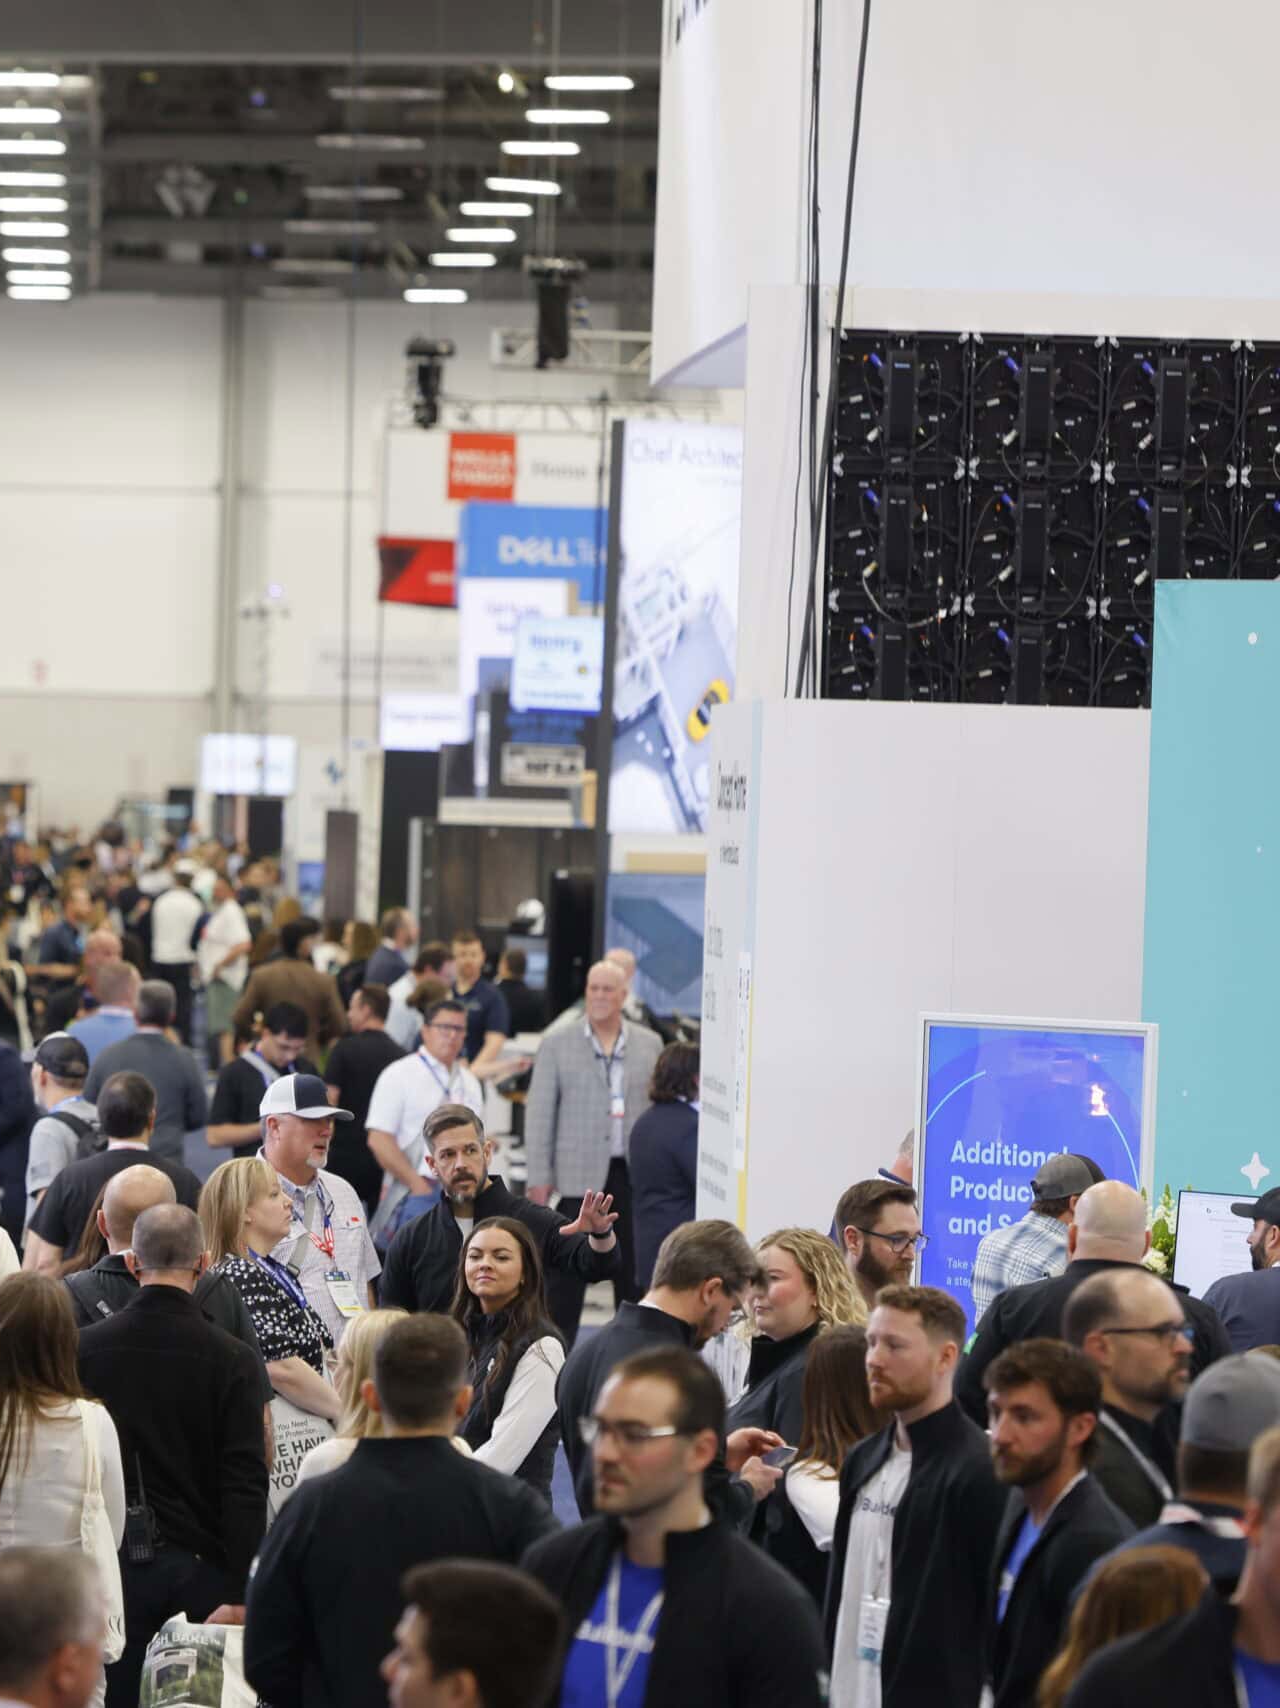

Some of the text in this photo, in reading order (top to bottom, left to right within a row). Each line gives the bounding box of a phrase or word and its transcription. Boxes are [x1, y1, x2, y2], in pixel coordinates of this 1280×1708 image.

[498, 536, 576, 566] DELL
[950, 1140, 1068, 1168] Addition
[950, 1175, 1035, 1202] Produc
[948, 1214, 991, 1236] and
[947, 1257, 968, 1270] Take
